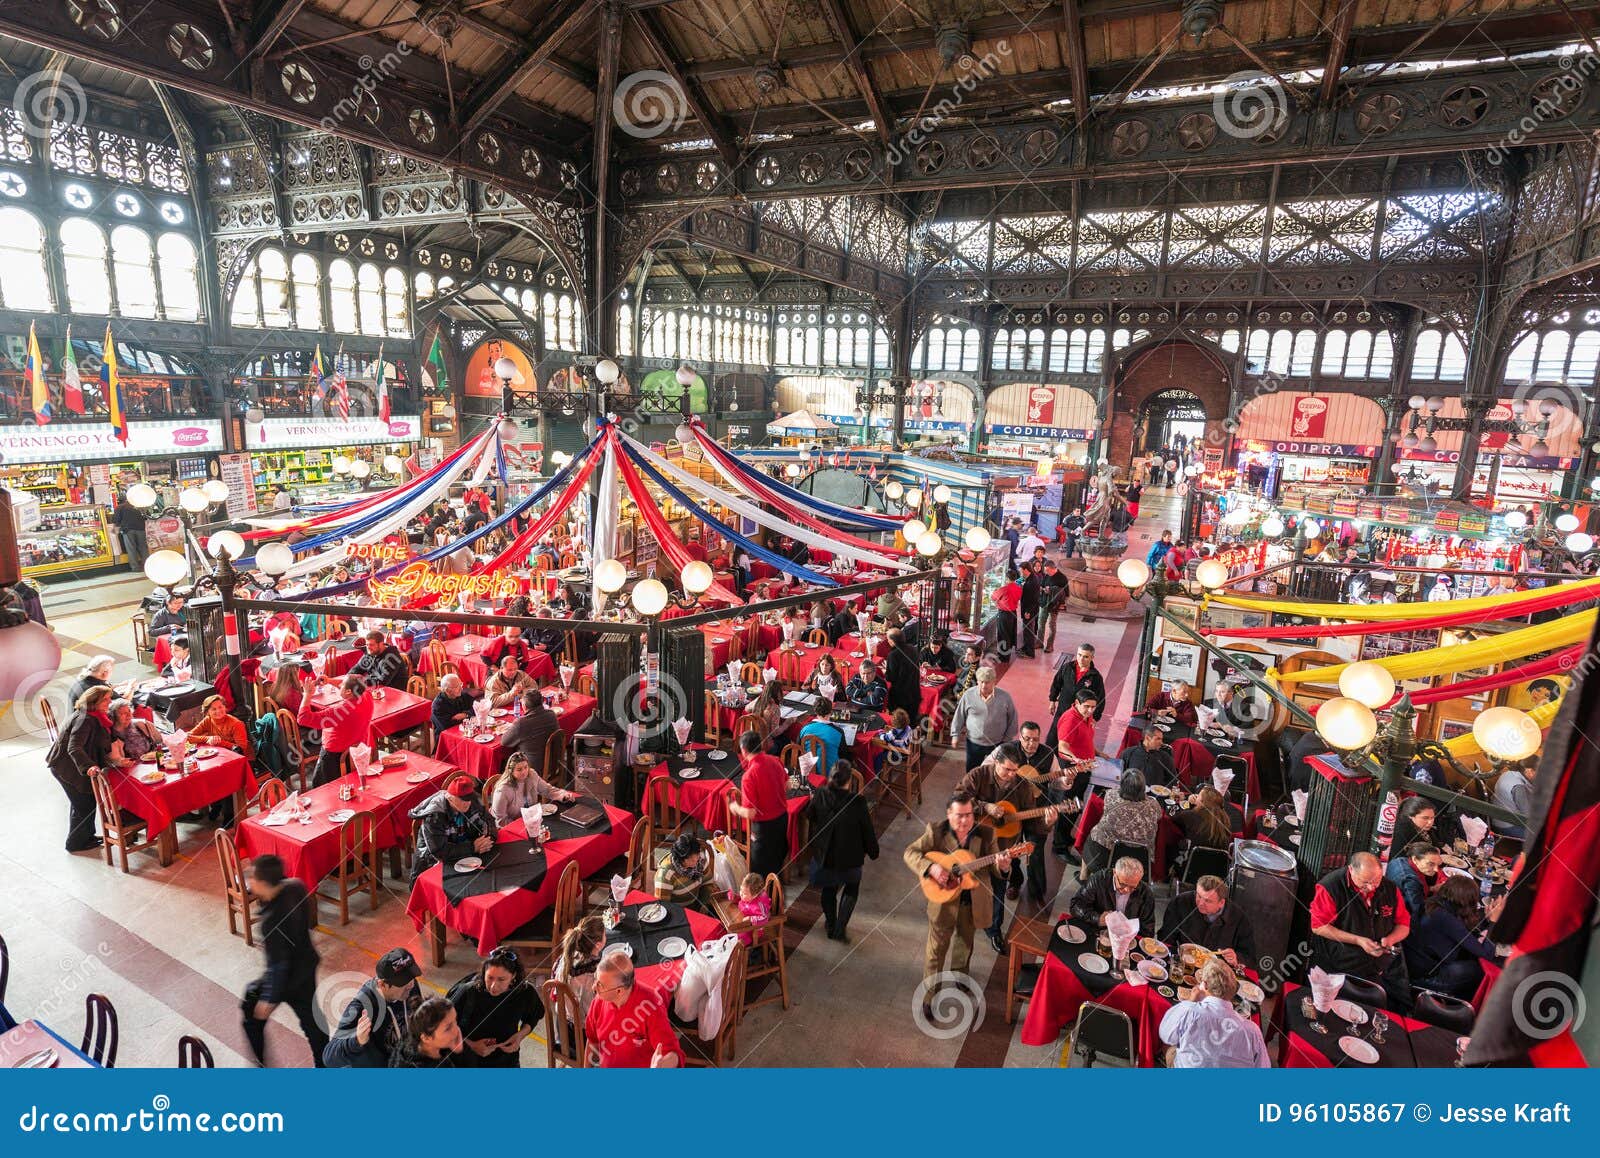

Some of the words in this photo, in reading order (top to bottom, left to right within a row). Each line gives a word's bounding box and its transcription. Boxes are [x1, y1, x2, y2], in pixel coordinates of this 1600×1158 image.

[886, 418, 945, 430] CDIPRA
[1003, 426, 1070, 438] CODIPRA
[93, 433, 104, 445] Y
[346, 543, 408, 560] DONDE
